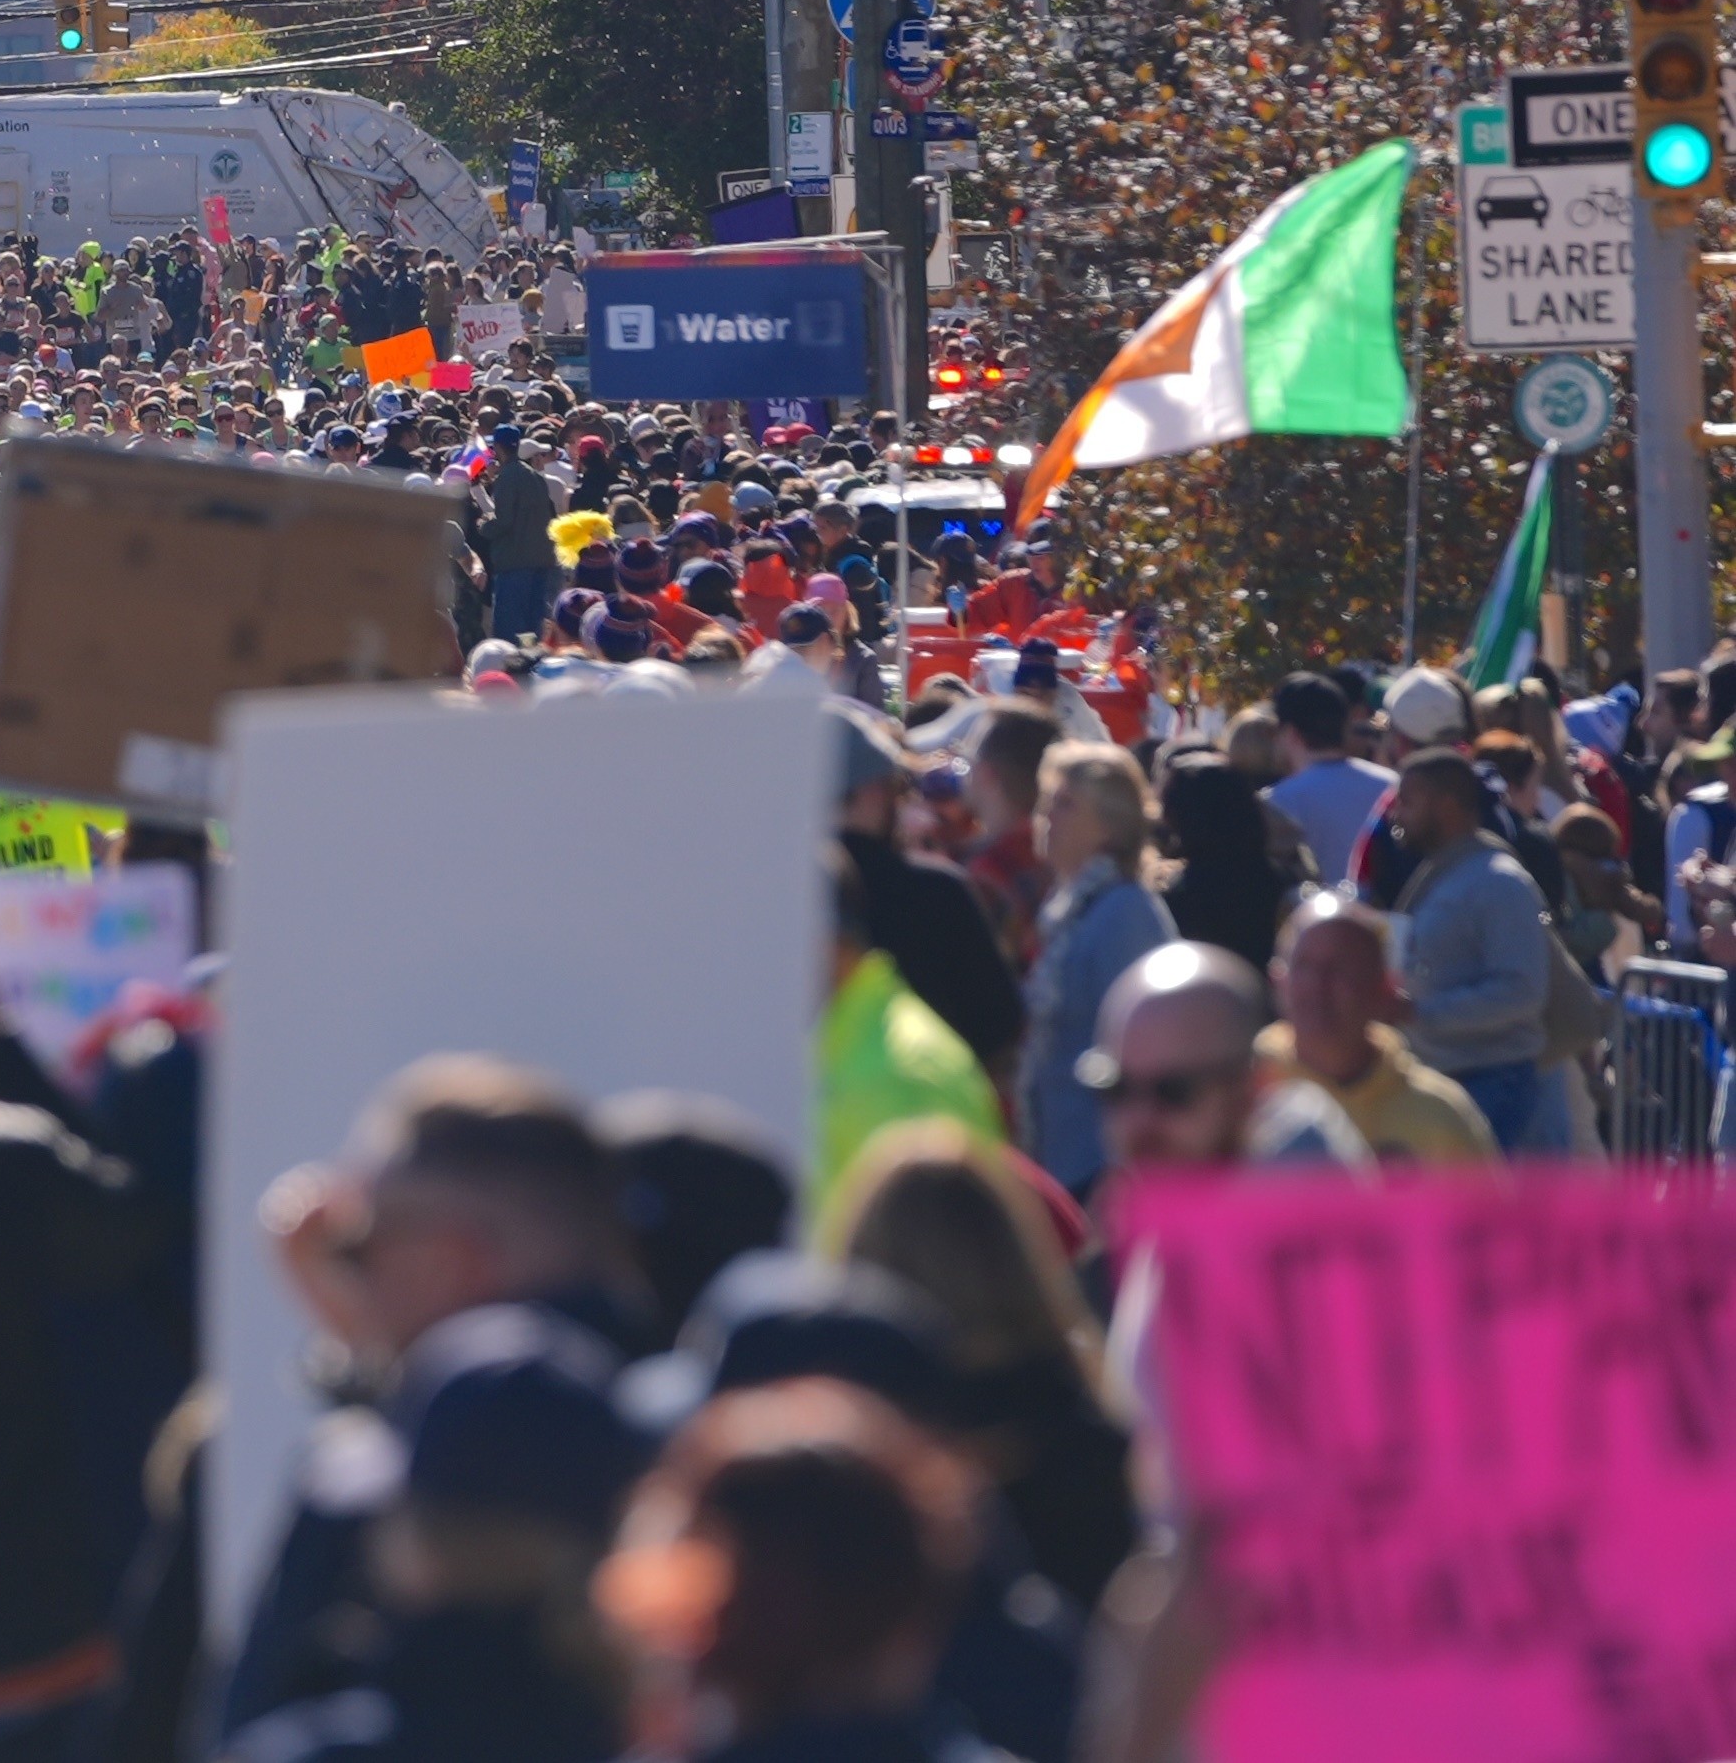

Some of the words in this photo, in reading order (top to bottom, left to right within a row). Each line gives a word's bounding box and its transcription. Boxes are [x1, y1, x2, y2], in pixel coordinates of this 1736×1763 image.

[1553, 99, 1634, 137] ONE
[1509, 290, 1616, 327] LANE
[677, 312, 792, 344] Water
